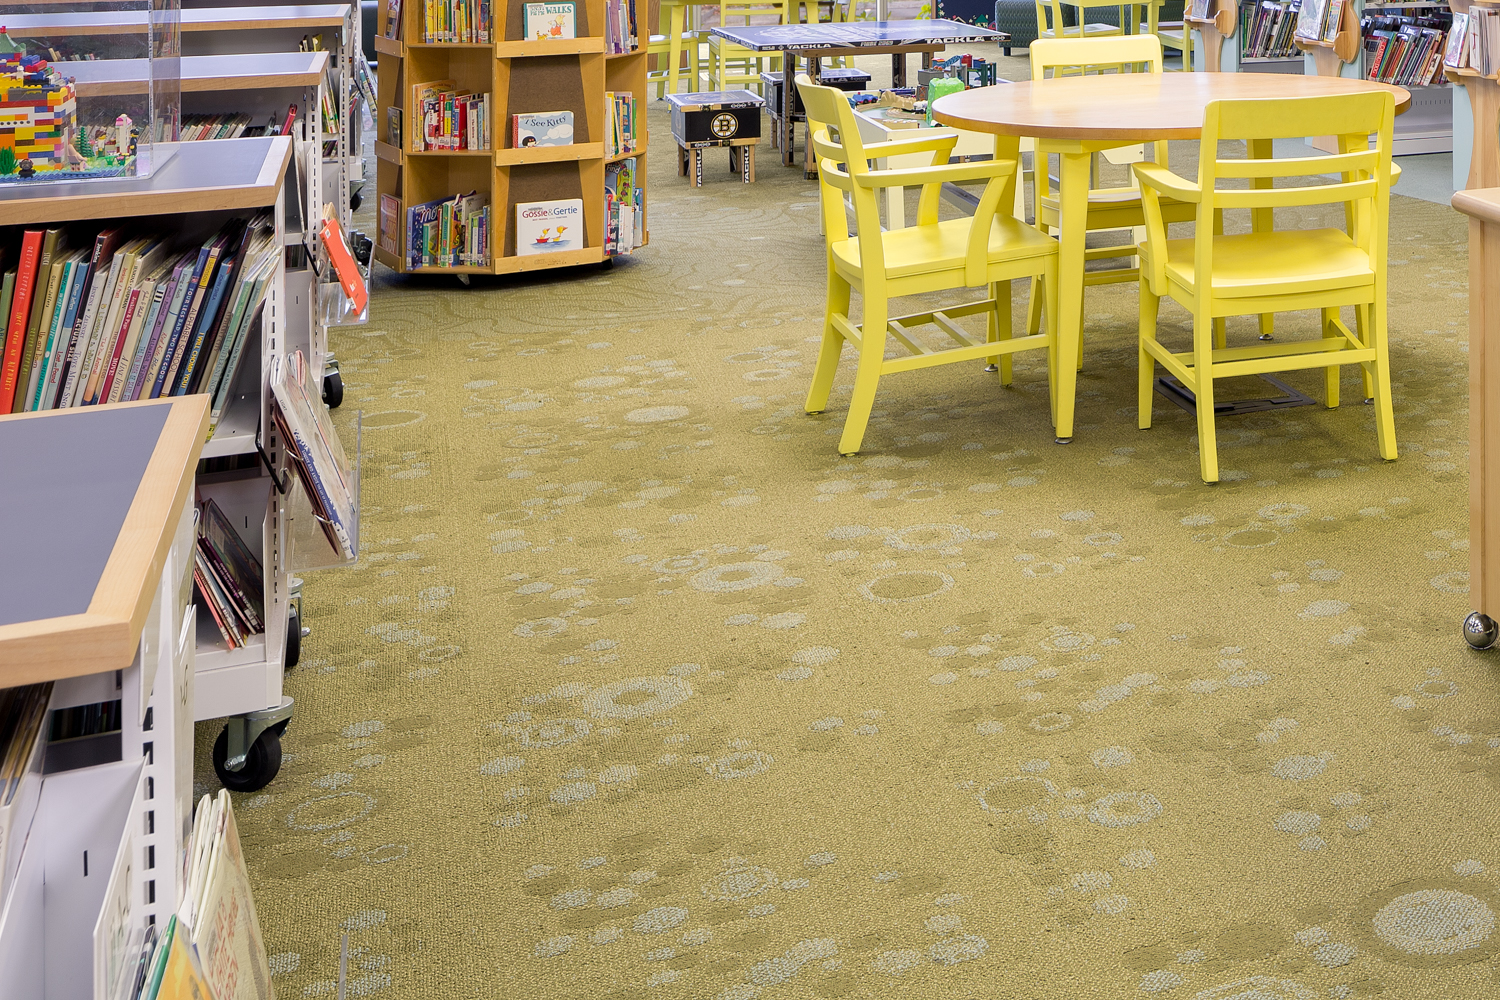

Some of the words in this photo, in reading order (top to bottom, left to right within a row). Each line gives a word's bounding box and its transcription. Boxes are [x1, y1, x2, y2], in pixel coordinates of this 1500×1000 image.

[546, 5, 572, 15] WALKS
[925, 36, 985, 44] TACKLA
[531, 118, 546, 127] See
[547, 115, 566, 127] Kitty
[522, 208, 548, 219] Gossie
[553, 206, 578, 216] Gertie
[72, 318, 82, 344] ACTUAL
[181, 307, 197, 342] ALPHABET
[170, 334, 178, 346] TWO
[67, 346, 76, 361] SIZE
[170, 344, 185, 372] SCHOOL
[187, 350, 198, 372] CHOMP
[93, 357, 101, 375] Animal
[51, 367, 59, 383] Found
